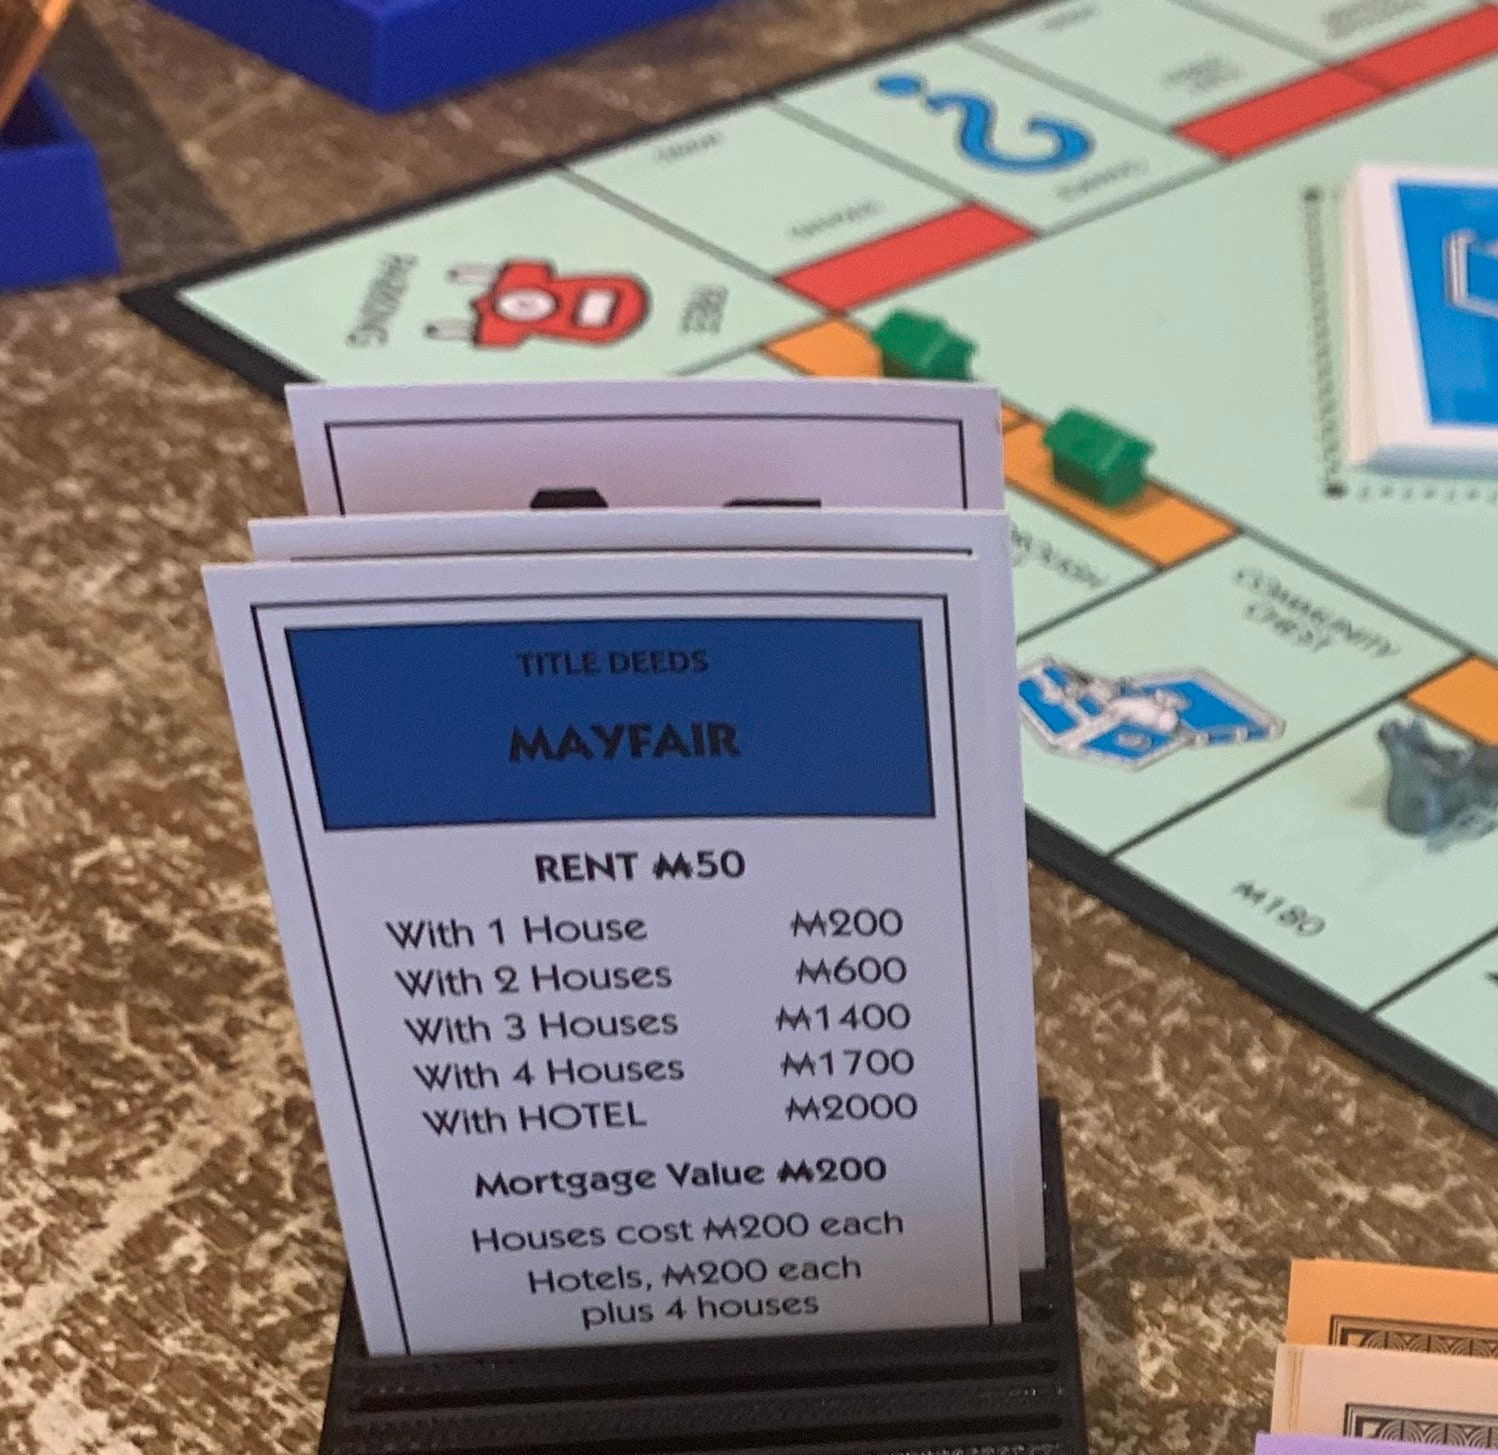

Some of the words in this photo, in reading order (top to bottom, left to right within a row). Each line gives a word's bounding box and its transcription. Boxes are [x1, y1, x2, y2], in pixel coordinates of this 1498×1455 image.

[516, 650, 598, 678] TITLE
[608, 649, 709, 675] DEEDS
[508, 721, 740, 762] MAYFAIR
[535, 851, 637, 884] RENT
[386, 918, 474, 950] With
[492, 917, 505, 945] 1
[524, 915, 648, 944] House
[395, 966, 482, 998] With
[494, 966, 519, 994] 2
[533, 962, 672, 993] Houses
[405, 1014, 491, 1046] With
[505, 1013, 526, 1041] 3
[541, 1010, 678, 1039] Houses
[414, 1060, 500, 1092] With
[512, 1059, 535, 1087] 4
[548, 1055, 684, 1085] Houses
[423, 1105, 508, 1138] With
[519, 1101, 648, 1132] HOTEL
[475, 1164, 655, 1202] Mortgage
[667, 1160, 765, 1189] Value
[471, 1223, 606, 1254] Houses
[616, 1217, 694, 1245] cost
[819, 1209, 903, 1236] each
[527, 1264, 652, 1296] Hotels,
[778, 1255, 861, 1281] each
[581, 1299, 654, 1331] plus
[665, 1295, 688, 1321] 4
[697, 1291, 819, 1320] houses
